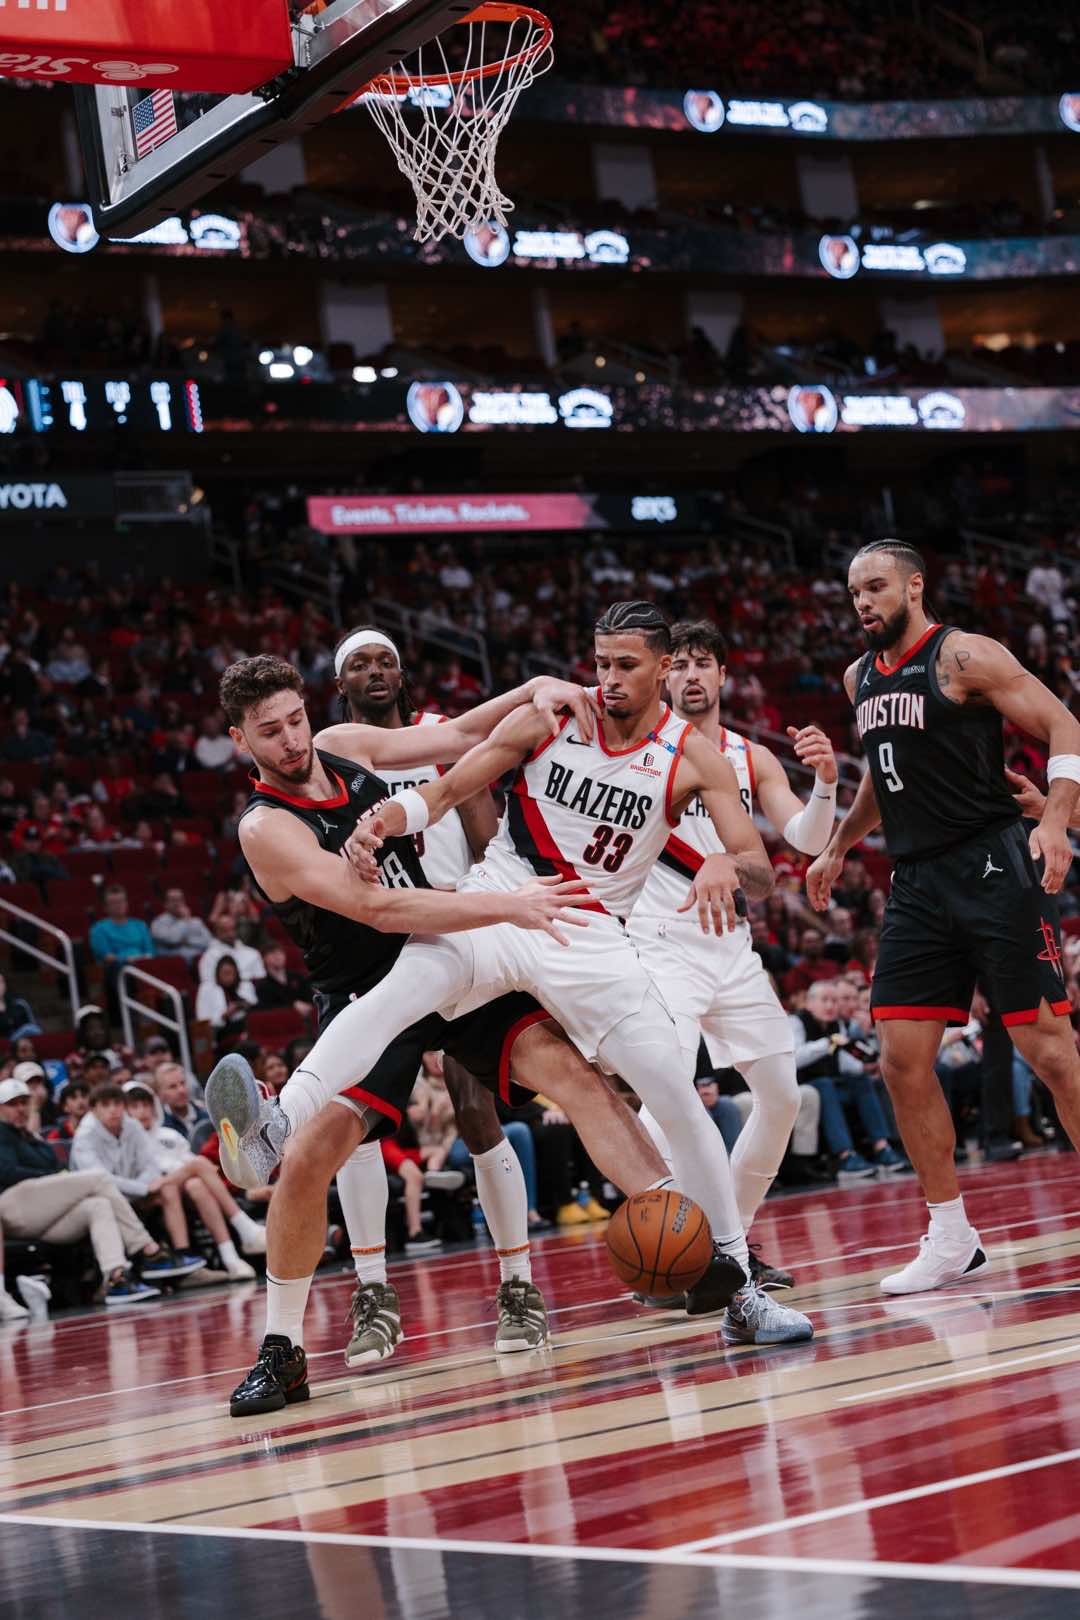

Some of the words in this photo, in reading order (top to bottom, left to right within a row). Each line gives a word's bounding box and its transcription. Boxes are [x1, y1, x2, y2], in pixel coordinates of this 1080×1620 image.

[856, 692, 925, 738] HOUSTON
[879, 742, 904, 793] 9
[544, 761, 653, 830] BLAZERS
[582, 824, 634, 874] 33
